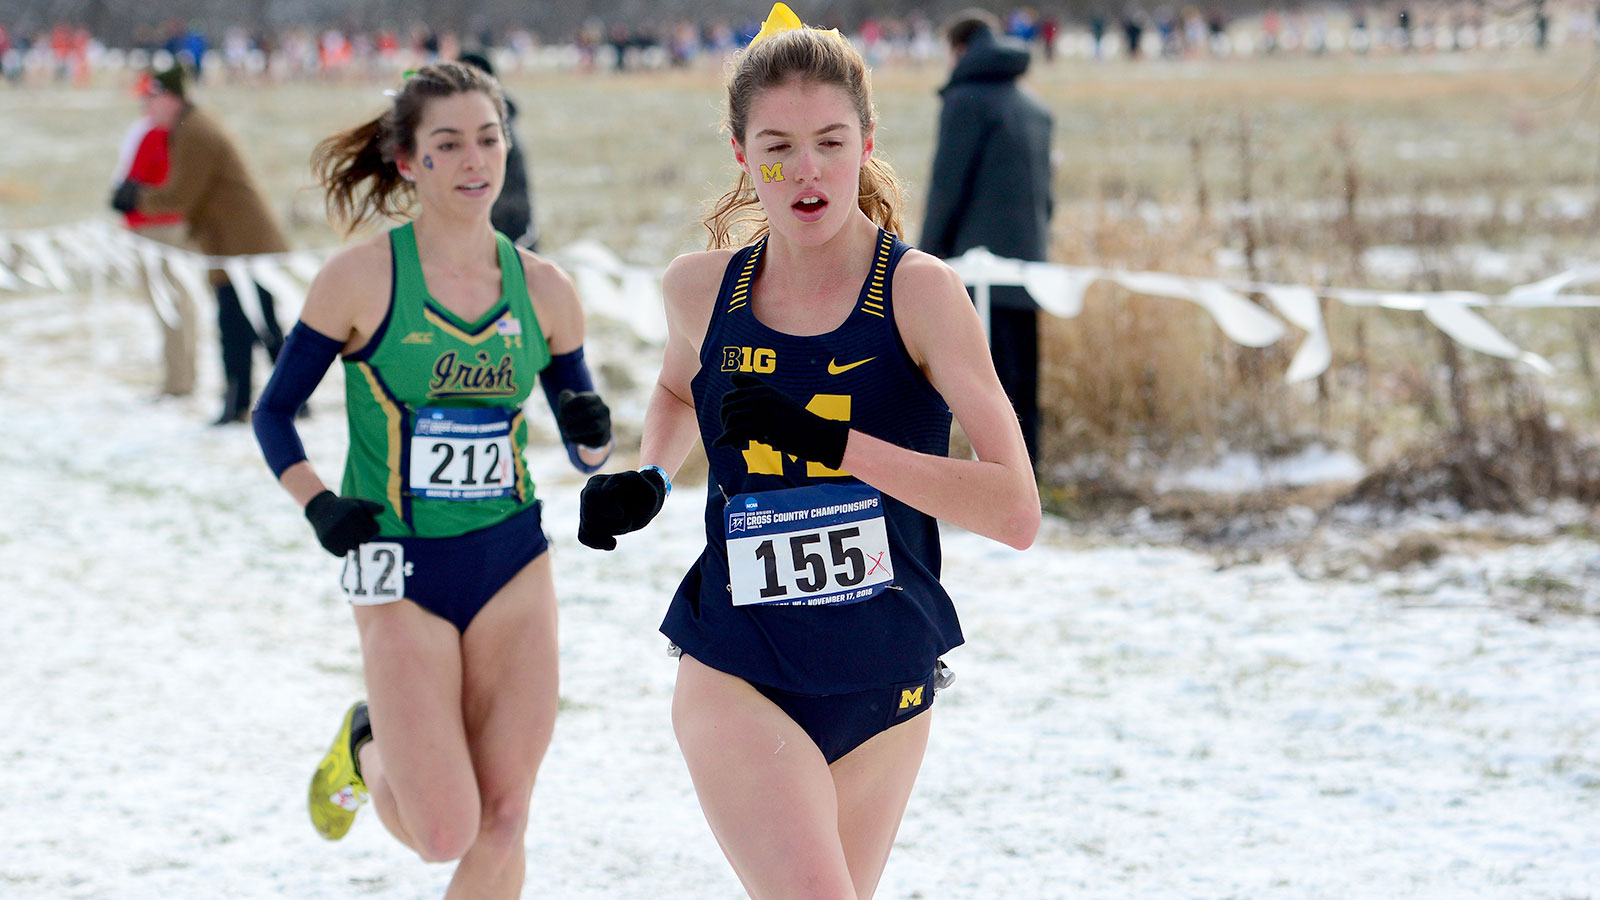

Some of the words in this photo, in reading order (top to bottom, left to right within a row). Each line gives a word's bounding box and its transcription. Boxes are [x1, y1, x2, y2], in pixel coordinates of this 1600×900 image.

[760, 162, 785, 183] M
[401, 332, 433, 344] ACC
[429, 350, 518, 392] Irish
[429, 442, 501, 485] 212
[746, 514, 772, 526] CROSS
[773, 509, 809, 523] COUNTRY
[810, 498, 878, 518] CHAMPIONSHIPS
[755, 526, 866, 599] 155
[807, 593, 845, 606] NOVEMBER
[899, 686, 924, 709] M
